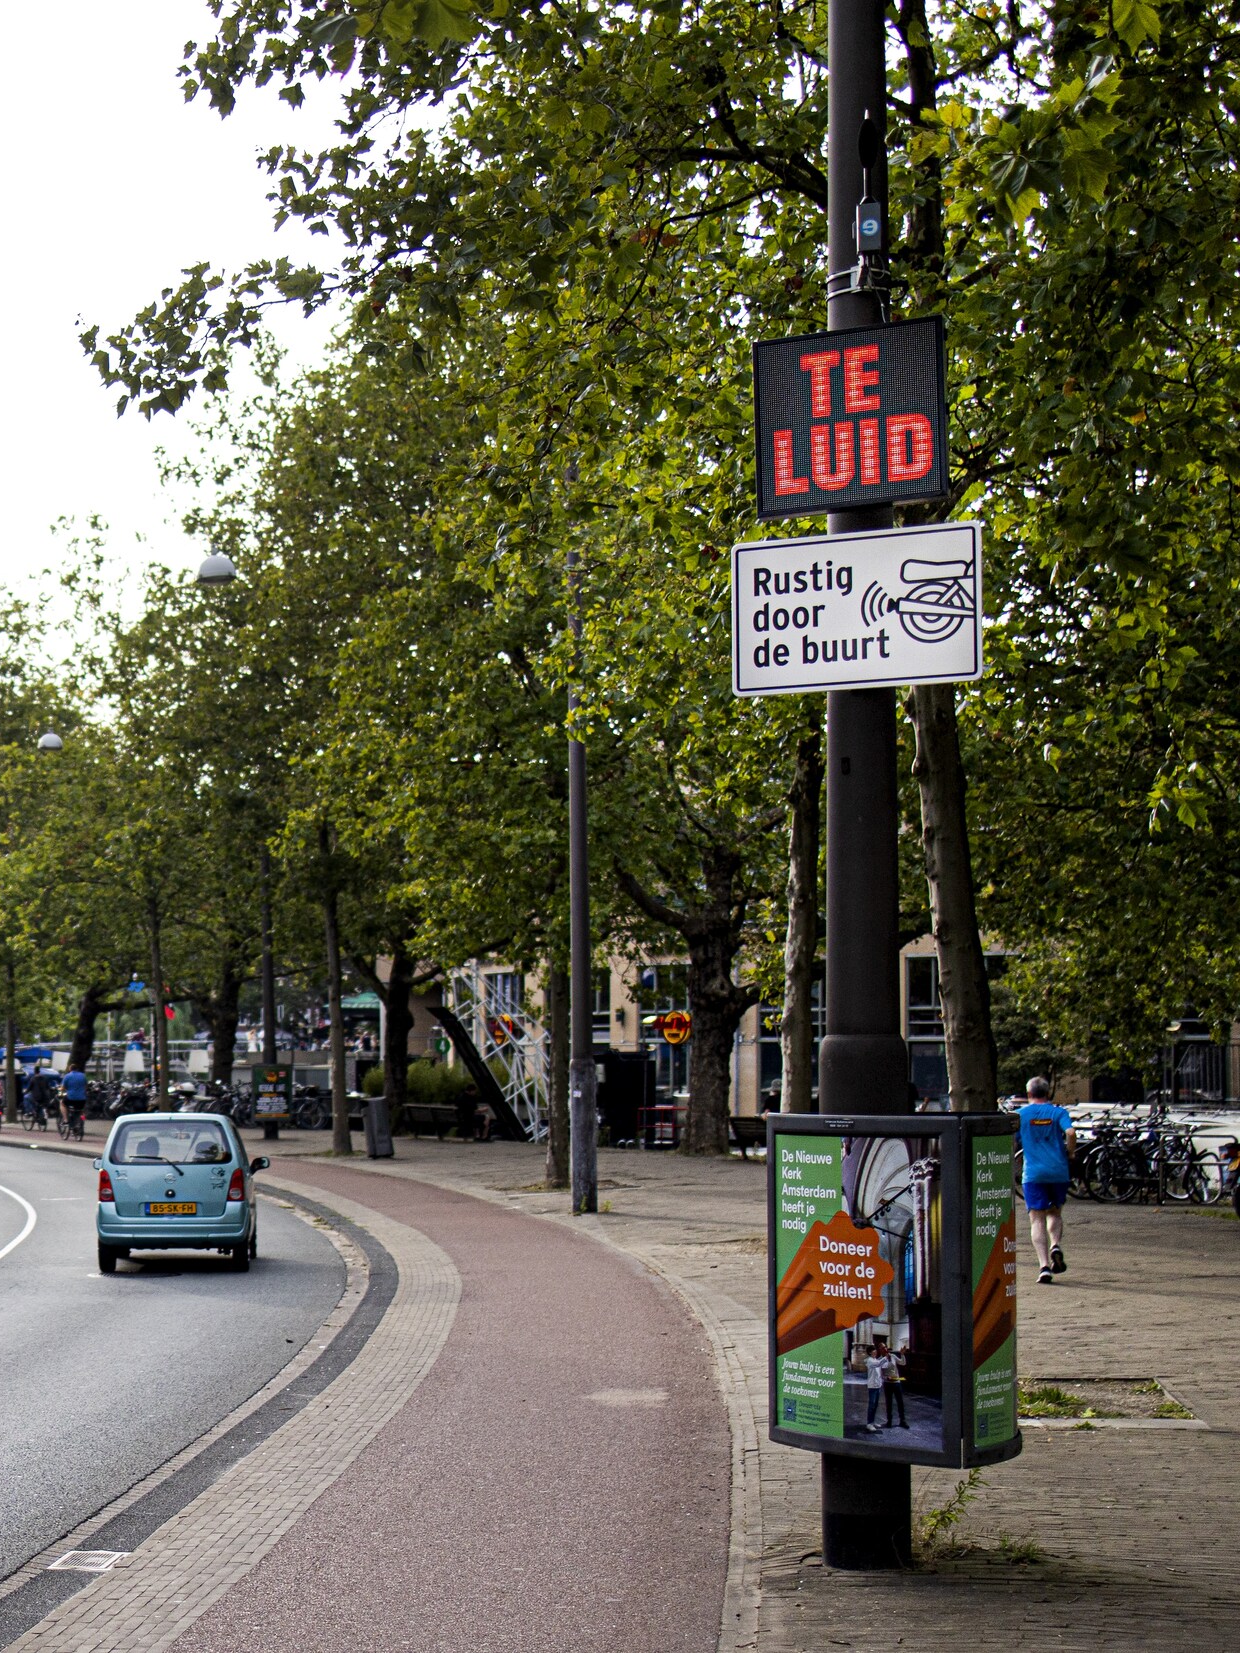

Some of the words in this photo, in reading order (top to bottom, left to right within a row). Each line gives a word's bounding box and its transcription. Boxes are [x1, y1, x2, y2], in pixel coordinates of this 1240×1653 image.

[800, 344, 881, 418] TE
[773, 413, 934, 496] LUID
[753, 561, 853, 597] Rustig
[753, 602, 825, 632] door
[753, 638, 790, 668] de
[802, 629, 890, 665] buurt
[782, 1150, 794, 1162] De
[796, 1150, 832, 1164] Nieuwe
[976, 1152, 986, 1165] De
[988, 1151, 1010, 1164] Nieuwe
[782, 1166, 802, 1180] Kerk
[976, 1170, 992, 1182] Kerk
[782, 1183, 836, 1198] Amsterdam
[976, 1187, 1012, 1201] Amsterdam
[152, 1204, 194, 1212] 85-SK-FH
[782, 1200, 804, 1214] heeft
[806, 1202, 815, 1218] je
[976, 1205, 994, 1218] heeft
[995, 1206, 1002, 1220] je
[782, 1218, 806, 1234] nodig
[976, 1222, 997, 1237] nodig
[819, 1236, 872, 1256] Doneer
[819, 1261, 851, 1276] voor
[855, 1262, 875, 1279] de
[823, 1281, 872, 1300] zuilen!
[782, 1358, 799, 1370] Jouw
[799, 1360, 814, 1374] hulp
[815, 1364, 821, 1374] is
[822, 1366, 835, 1375] een
[782, 1371, 816, 1386] fundament
[818, 1378, 836, 1388] voor
[783, 1383, 790, 1393] de
[791, 1384, 820, 1398] toekomst
